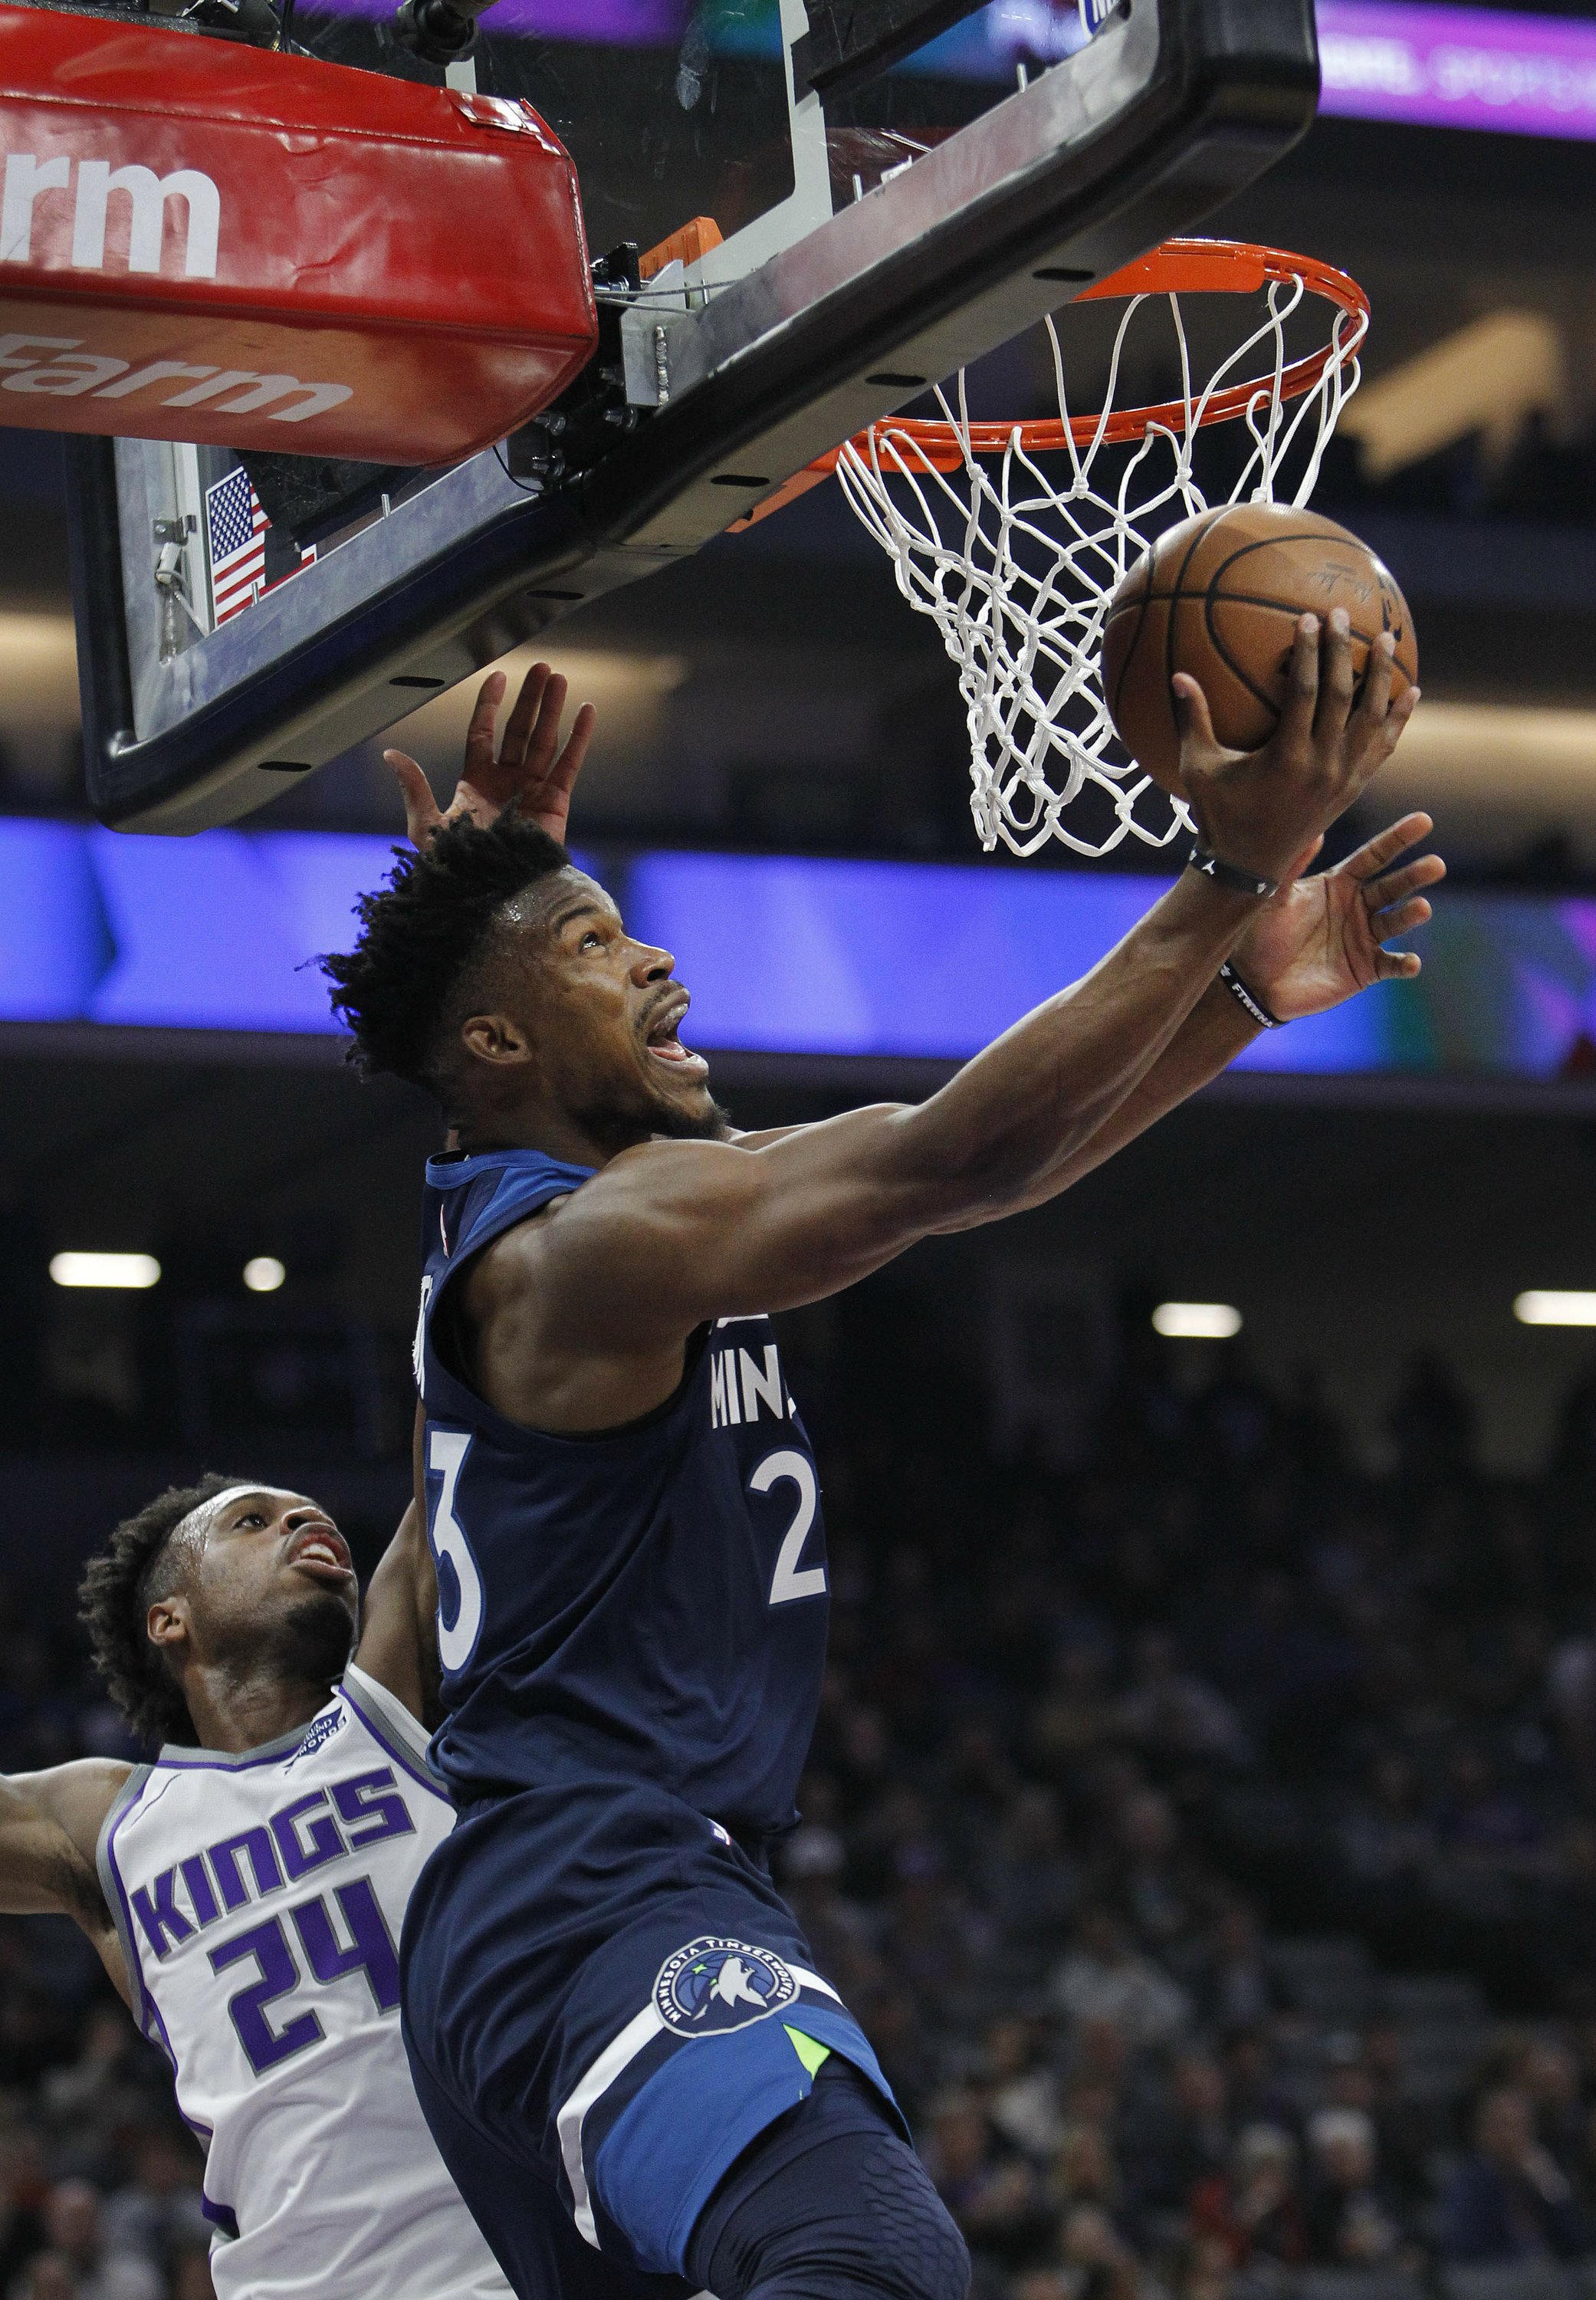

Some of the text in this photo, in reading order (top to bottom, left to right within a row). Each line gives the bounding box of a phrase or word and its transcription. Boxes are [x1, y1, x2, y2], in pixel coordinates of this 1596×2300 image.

[0, 333, 353, 422] Farm
[711, 1344, 796, 1429] MIN
[429, 1431, 481, 1671] 3
[749, 1450, 827, 1605] 2
[130, 1766, 416, 1963] KINGS
[206, 1875, 402, 2078] 24
[658, 1939, 794, 2023] MINNESOTA TIMBERWOLVES
